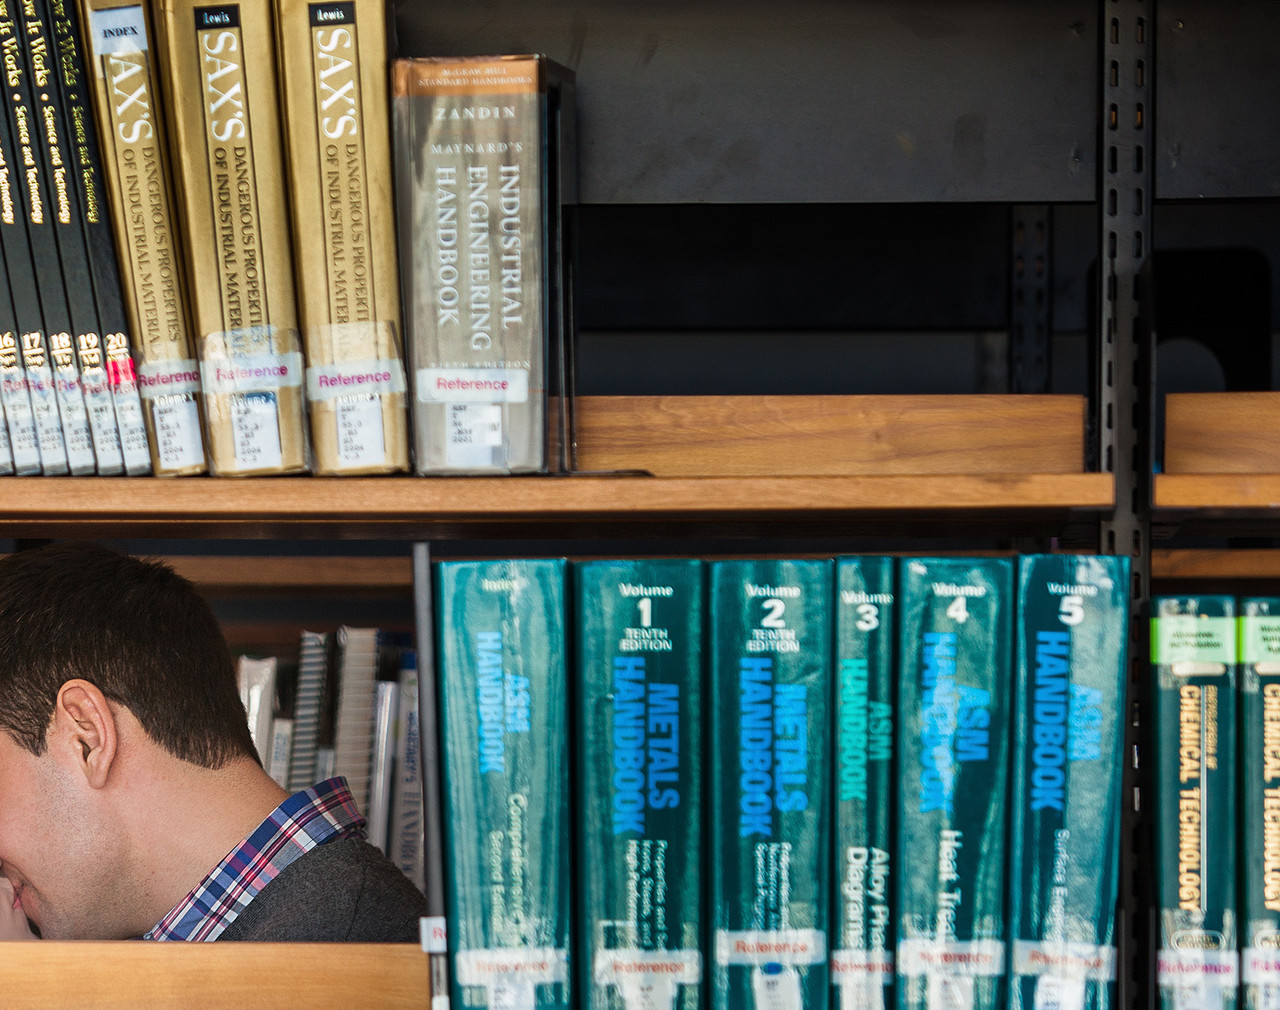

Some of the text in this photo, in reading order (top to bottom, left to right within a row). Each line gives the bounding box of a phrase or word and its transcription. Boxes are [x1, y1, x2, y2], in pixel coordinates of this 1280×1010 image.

[103, 26, 138, 39] INDEX
[204, 10, 230, 24] Lewis
[316, 8, 345, 21] Lewis
[109, 52, 153, 144] AX'S
[202, 31, 246, 142] SAX'S
[315, 28, 358, 139] SAX'S
[27, 20, 70, 224] It Works Science and Technology
[435, 106, 516, 120] ZANDIN
[122, 148, 137, 170] OF
[431, 142, 524, 154] MAYNARD'S
[126, 175, 151, 269] INDUSTRIAL
[142, 146, 182, 342] DANGEROUS PROPERTIES
[233, 146, 263, 343] DANGEROUS PROPERTIES
[435, 165, 460, 326] HANDBOOK
[499, 164, 522, 328] INDUSTRIAL
[213, 147, 246, 360] OF INDUSTRIAL MATERIALS
[468, 165, 492, 353] ENGINEERING
[79, 332, 98, 349] 19
[106, 332, 127, 350] 20
[216, 364, 289, 382] Reference
[318, 371, 392, 388] Reference
[436, 377, 509, 390] Reference
[619, 583, 673, 598] Volume
[638, 599, 653, 626] 1
[747, 584, 801, 599] Volume
[761, 599, 786, 628] 2
[946, 596, 969, 623] 4
[1058, 598, 1084, 626] 5
[625, 628, 669, 640] TENTH
[856, 605, 880, 632] 3
[621, 639, 673, 652] EDITION
[612, 656, 646, 836] HANDBOOK
[648, 683, 680, 809] METALS
[739, 657, 773, 838] HANDBOOK
[774, 684, 809, 812] METALS
[840, 658, 868, 800] HANDBOOK
[867, 701, 892, 760] ASM
[956, 685, 991, 761] ASM
[1031, 631, 1070, 812] HANDBOOK
[1179, 684, 1201, 911] CHEMICAL TECHNOLOGY
[867, 847, 890, 900] Alloy
[937, 830, 963, 884] Heat
